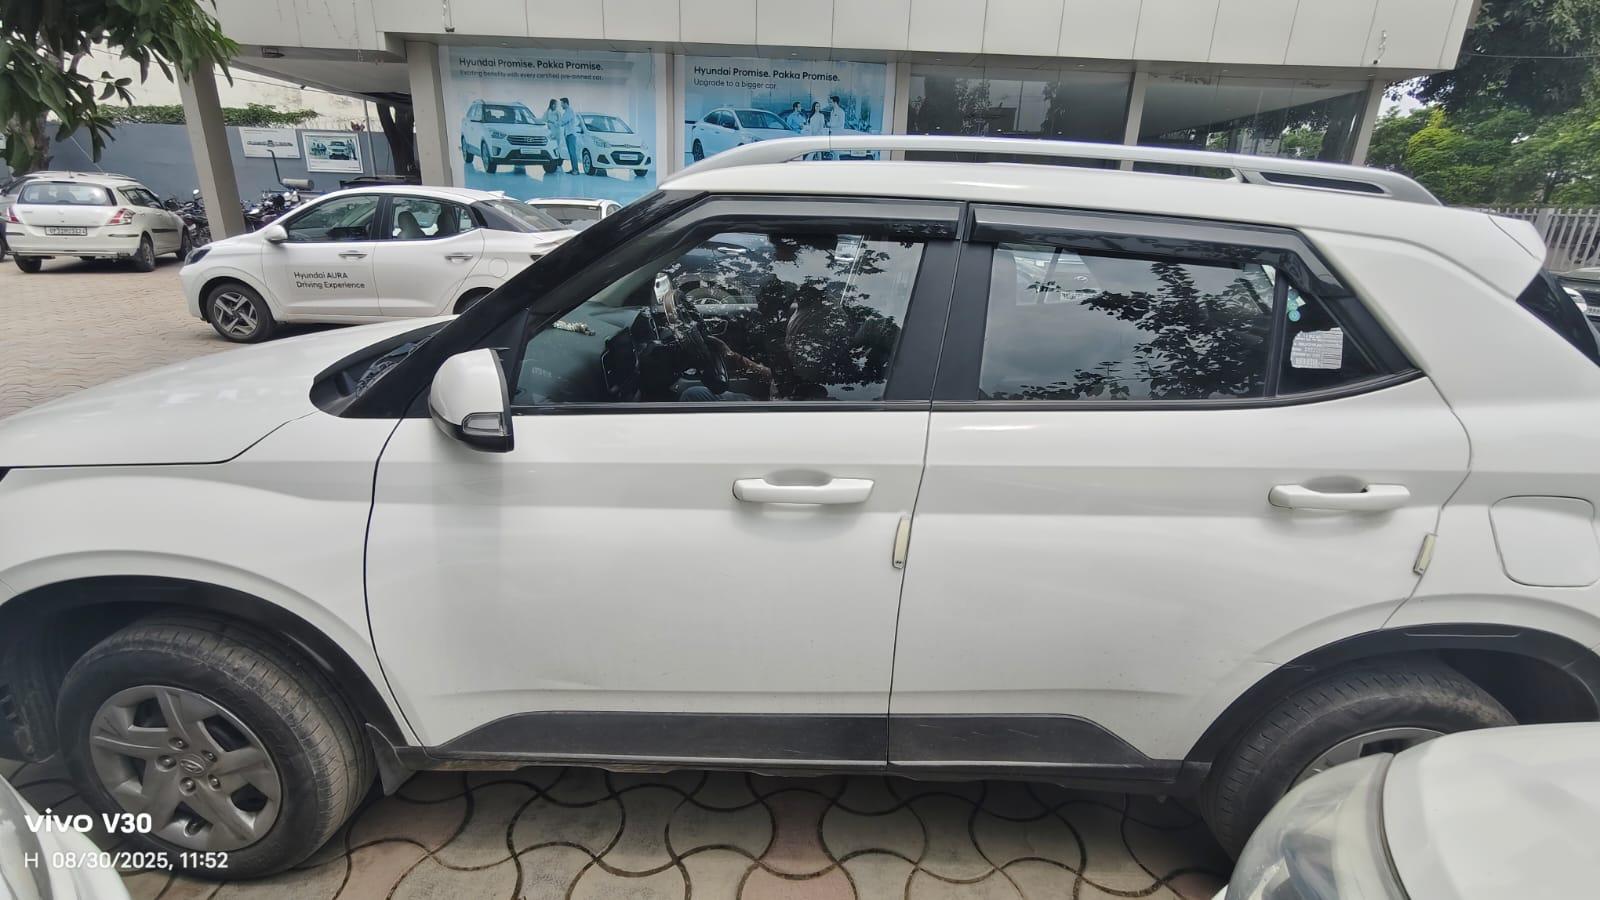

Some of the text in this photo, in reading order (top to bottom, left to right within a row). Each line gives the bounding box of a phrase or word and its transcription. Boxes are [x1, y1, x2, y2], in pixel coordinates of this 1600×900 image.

[459, 57, 604, 70] Hyundai Promise. Pakka Promise.
[694, 66, 841, 81] Hyundai Promise. Pakka Promise.
[694, 79, 725, 87] Upgrade
[741, 81, 764, 90] bigger
[294, 271, 326, 280] Hyundai
[296, 281, 366, 289] Driving Experience
